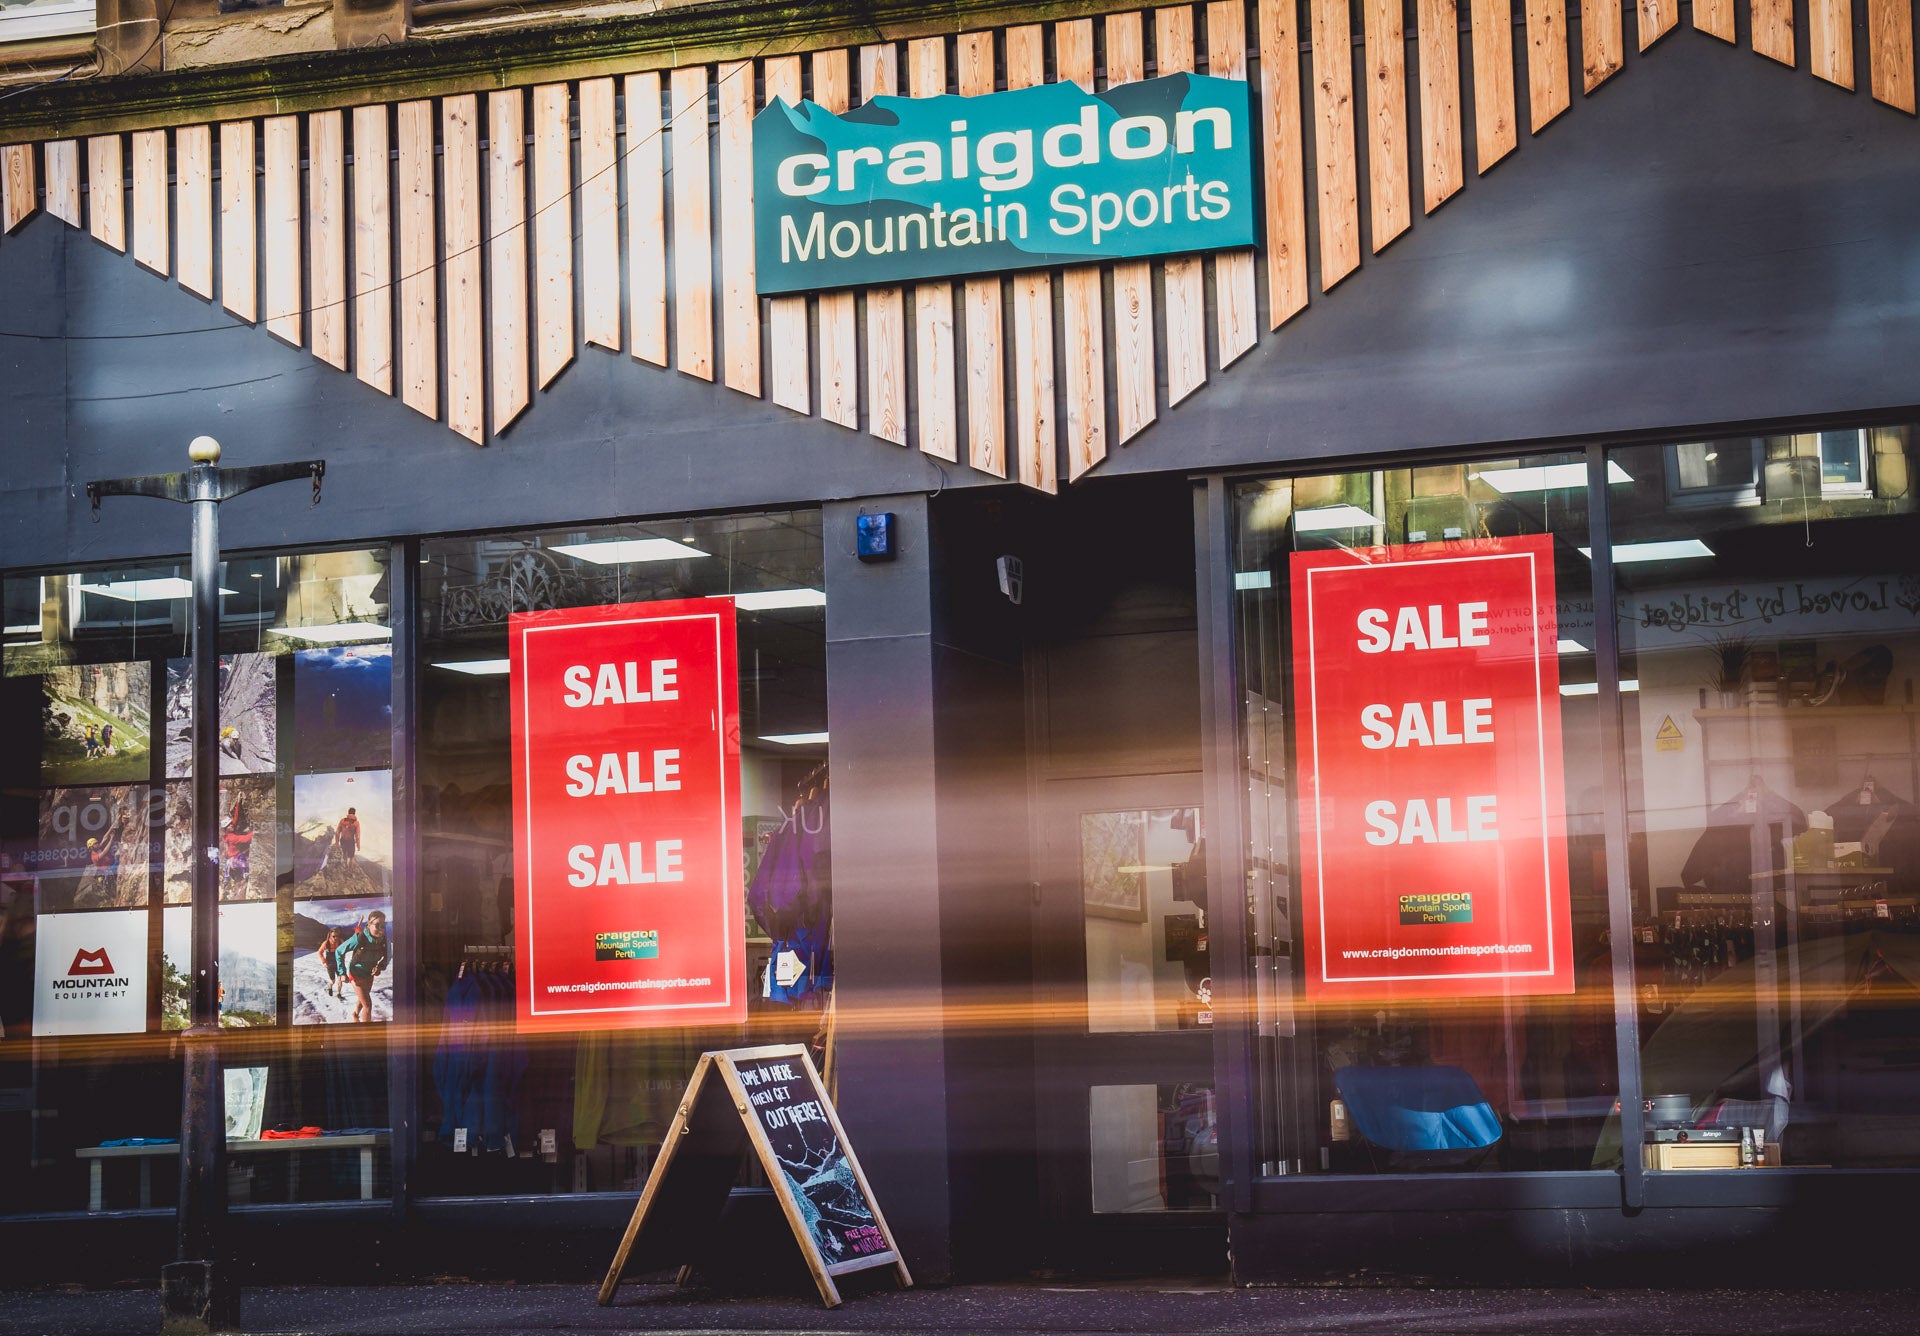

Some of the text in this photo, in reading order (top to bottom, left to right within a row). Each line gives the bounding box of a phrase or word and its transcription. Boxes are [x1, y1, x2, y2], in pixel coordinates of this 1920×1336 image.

[776, 104, 1232, 197] craigdon
[780, 172, 1231, 263] Mountain Sports
[1357, 601, 1490, 654] SALE
[563, 659, 679, 708] SALE
[1361, 697, 1495, 750] SALE
[565, 749, 681, 798] SALE
[1364, 794, 1500, 846] SALE
[567, 839, 684, 888] SALE
[1399, 892, 1471, 904] craigdon
[1400, 902, 1471, 913] Mountain Sports
[1423, 914, 1447, 922] Perth
[595, 930, 657, 942] craigdon
[596, 940, 657, 950] Mountain Sports
[615, 950, 636, 958] Perth
[1342, 944, 1532, 960] www.craigdonmountainsports.com
[53, 978, 129, 989] MOUNTAIN
[547, 976, 711, 993] www.craigdonmountainsports.com
[55, 991, 126, 1000] EQUIPMENT
[750, 1086, 791, 1106] THEN GET
[765, 1100, 827, 1129] OUT THERE!
